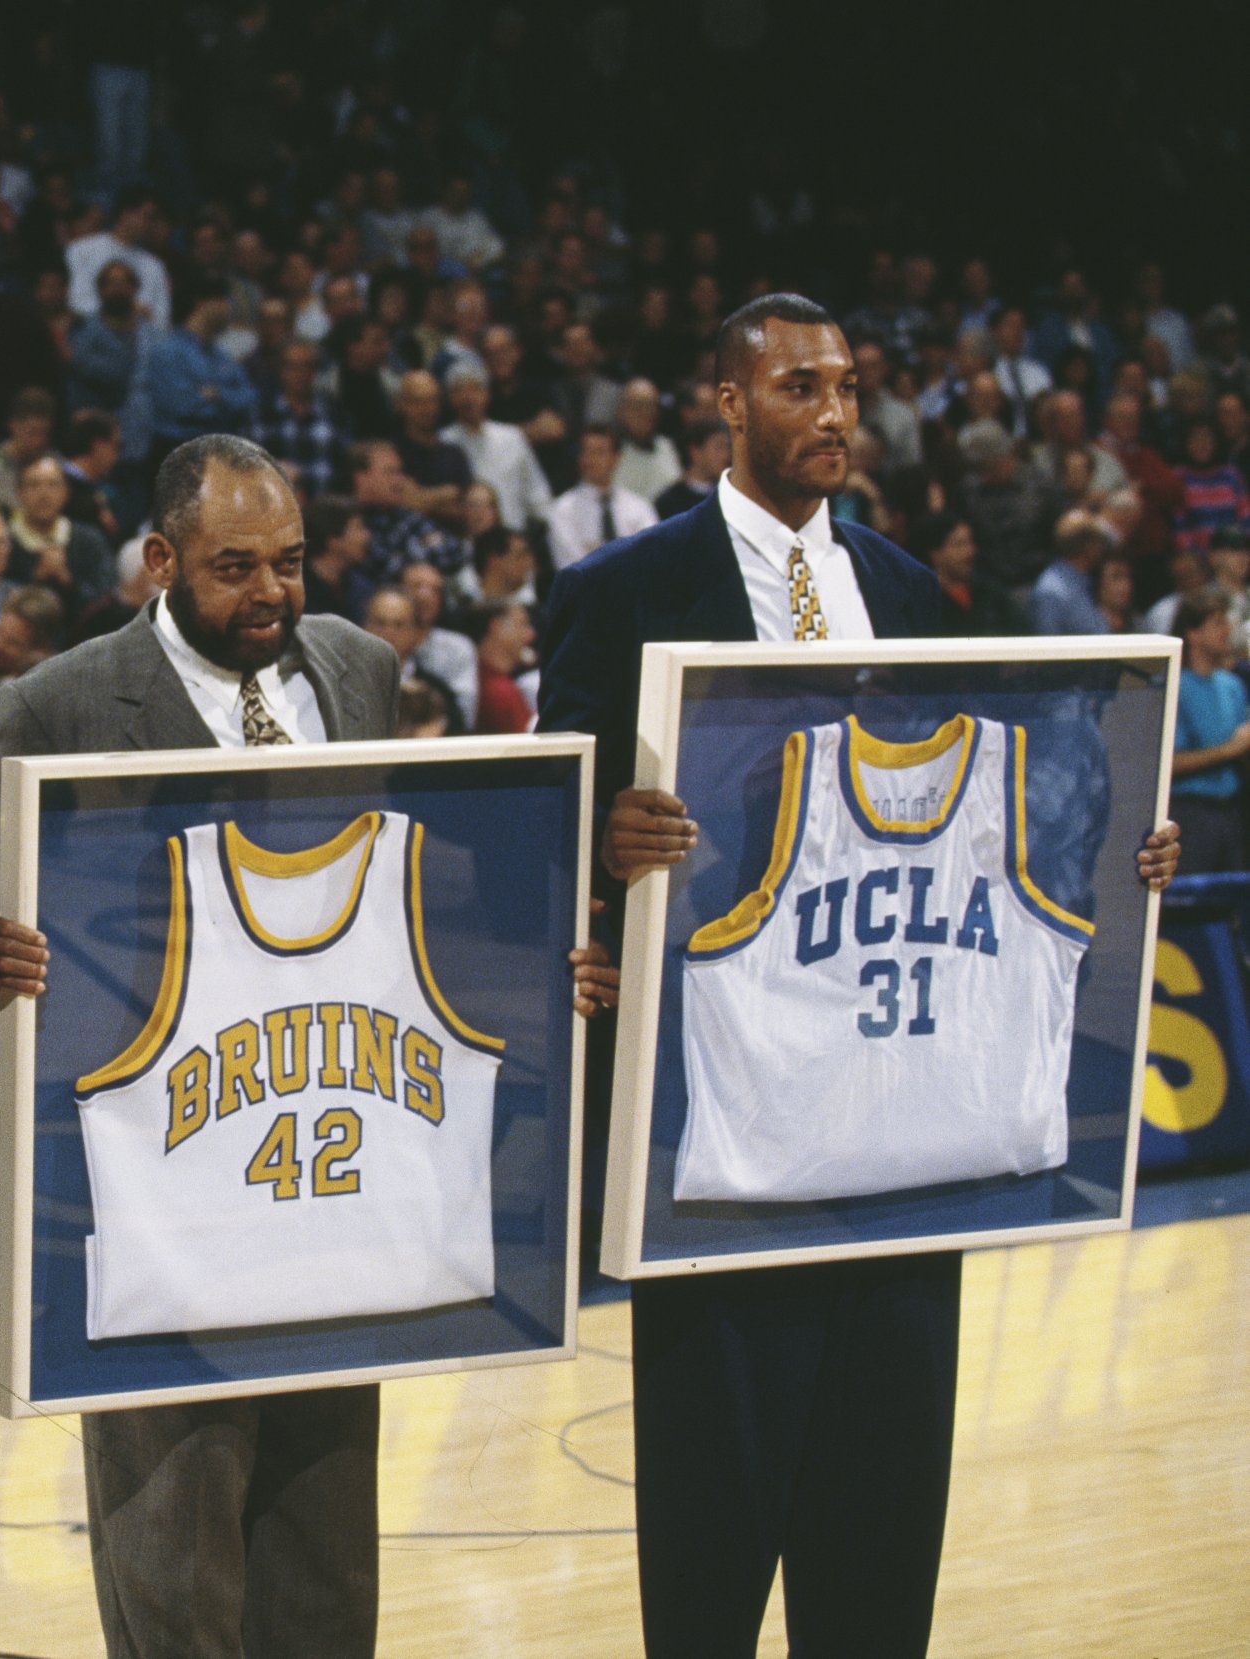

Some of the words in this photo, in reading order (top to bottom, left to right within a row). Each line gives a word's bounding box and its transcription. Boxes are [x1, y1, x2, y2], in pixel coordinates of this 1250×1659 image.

[795, 866, 999, 967] UCLA
[857, 956, 936, 1038] 31
[164, 1001, 445, 1156] BRUINS
[245, 1107, 363, 1202] 42
